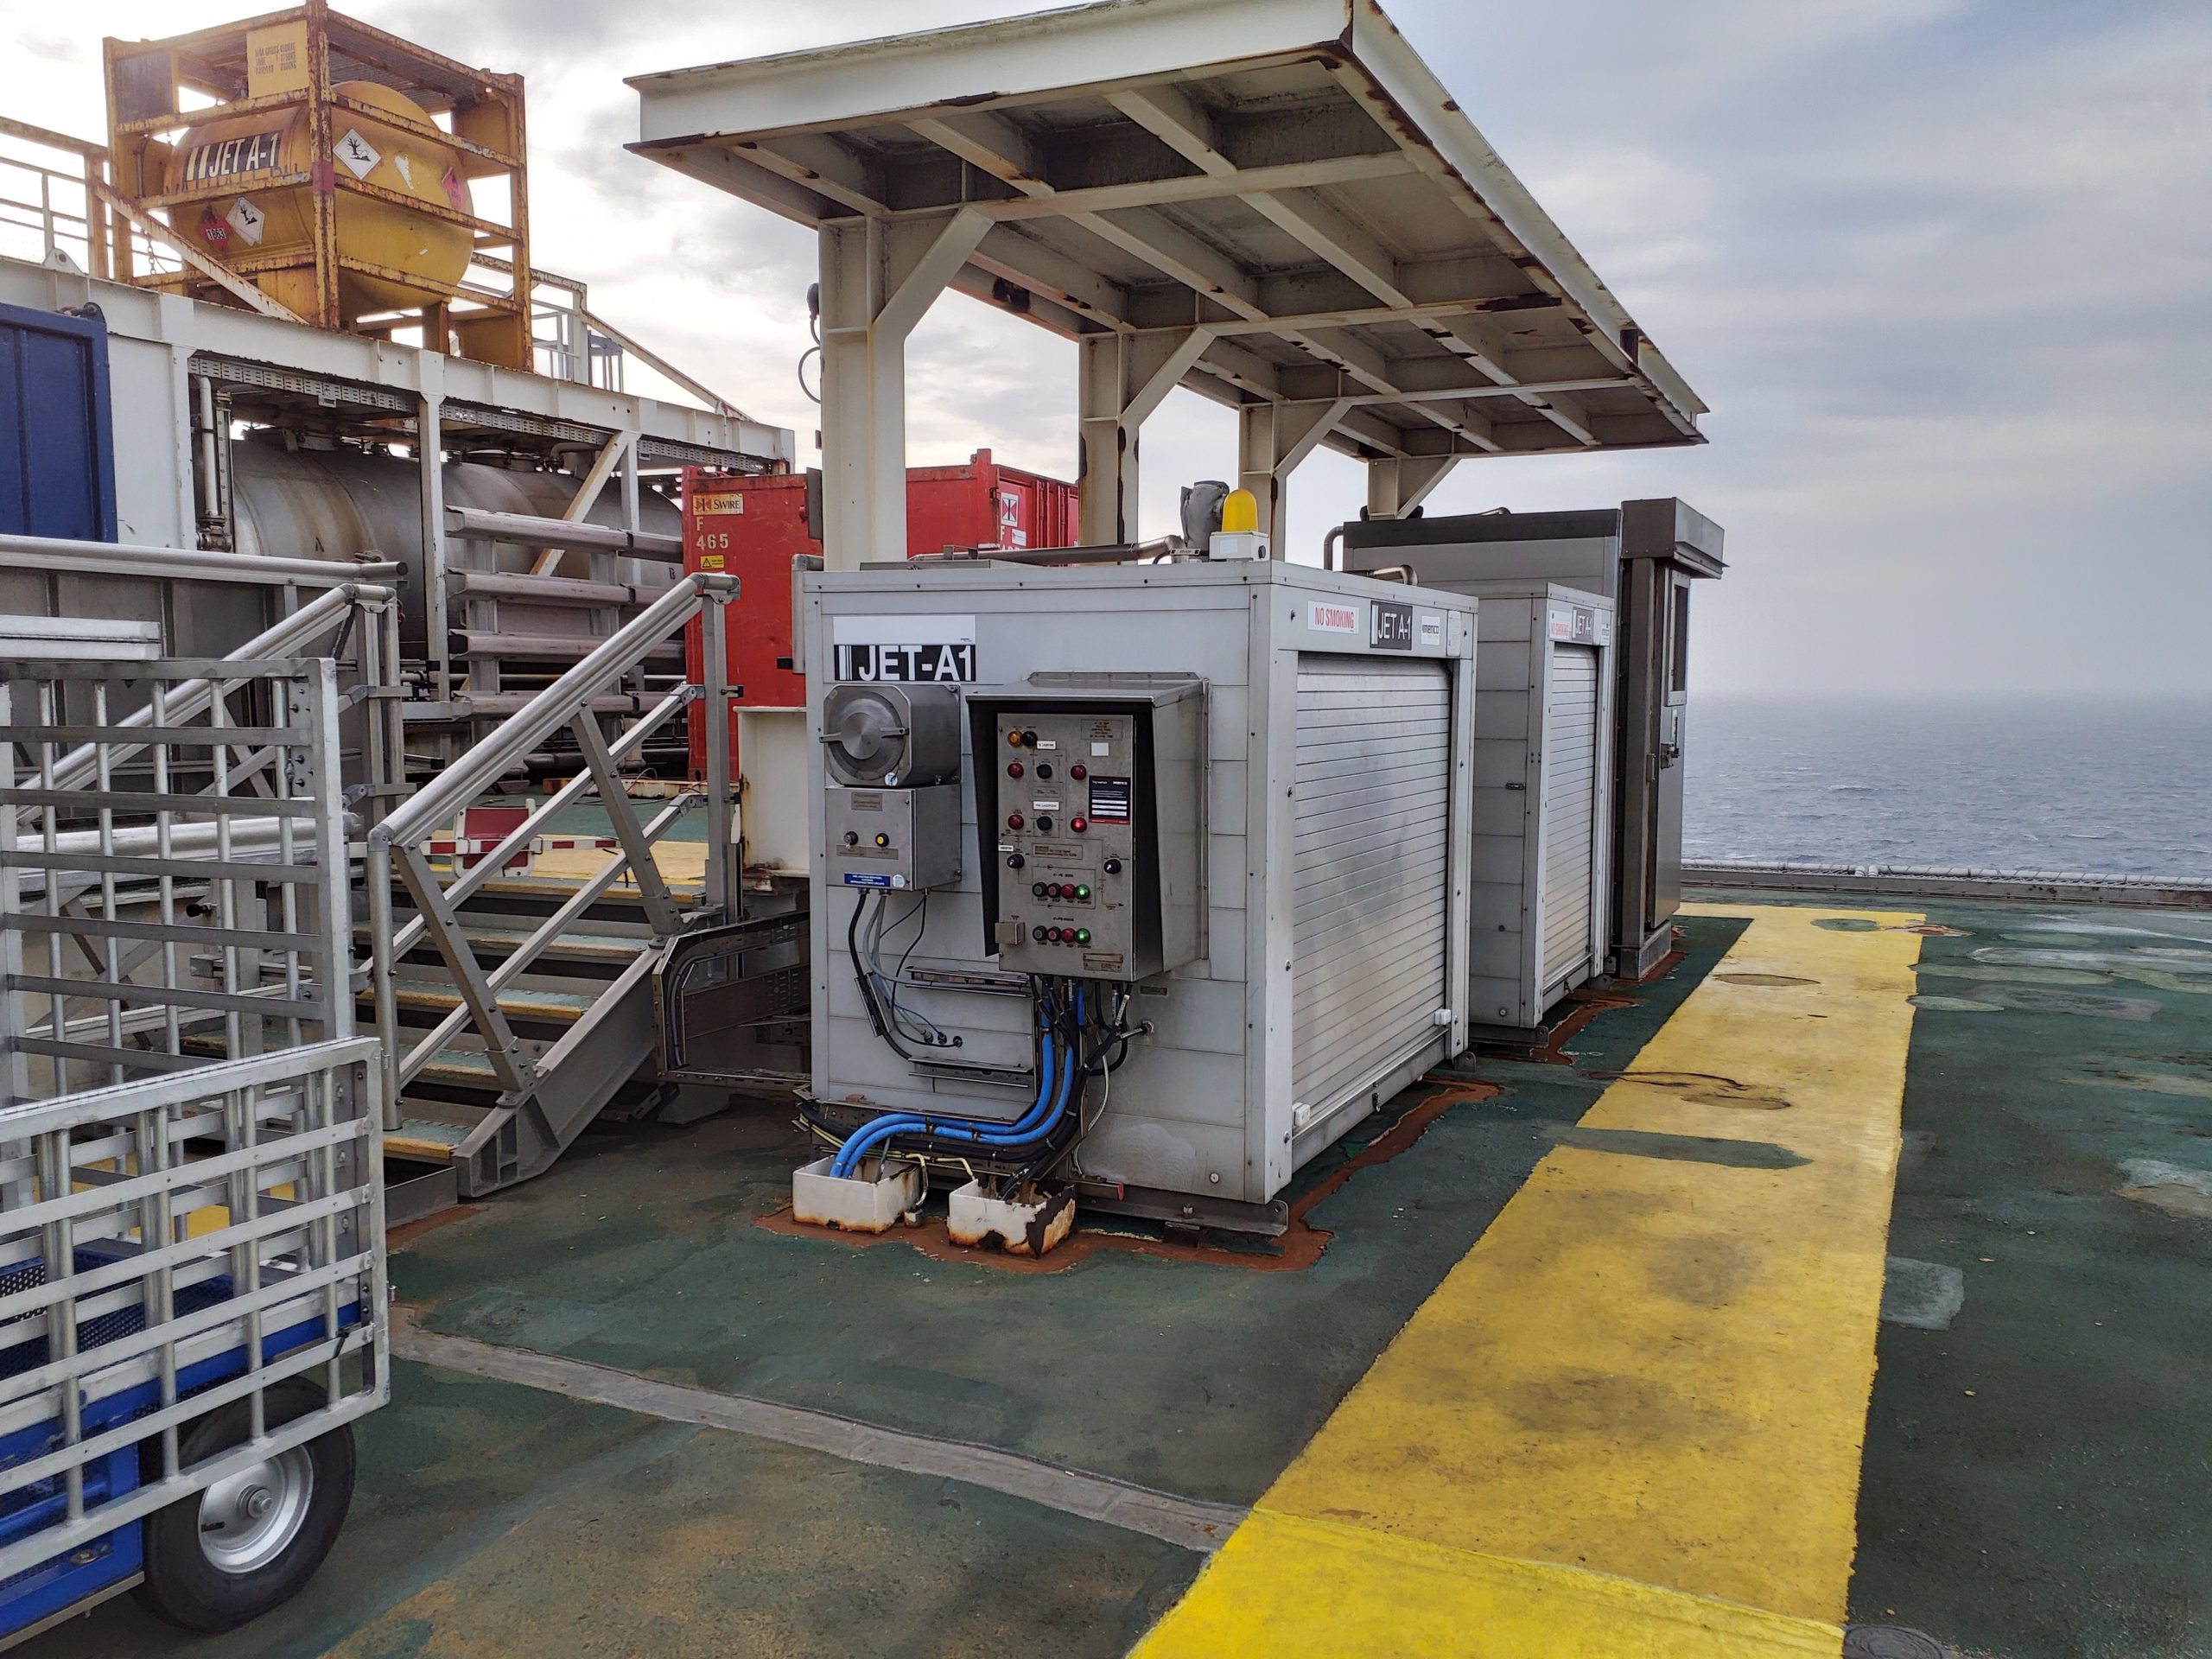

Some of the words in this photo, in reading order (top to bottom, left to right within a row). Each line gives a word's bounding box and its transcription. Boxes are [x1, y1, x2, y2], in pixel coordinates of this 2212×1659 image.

[208, 138, 245, 178] JET
[245, 132, 278, 171] A-1
[696, 516, 704, 531] F
[696, 533, 728, 551] 465
[1314, 607, 1325, 626] NO
[1325, 608, 1355, 630] SMOKING
[1377, 612, 1397, 640] JET
[1397, 613, 1412, 641] A-1
[858, 645, 972, 682] JET-A1
